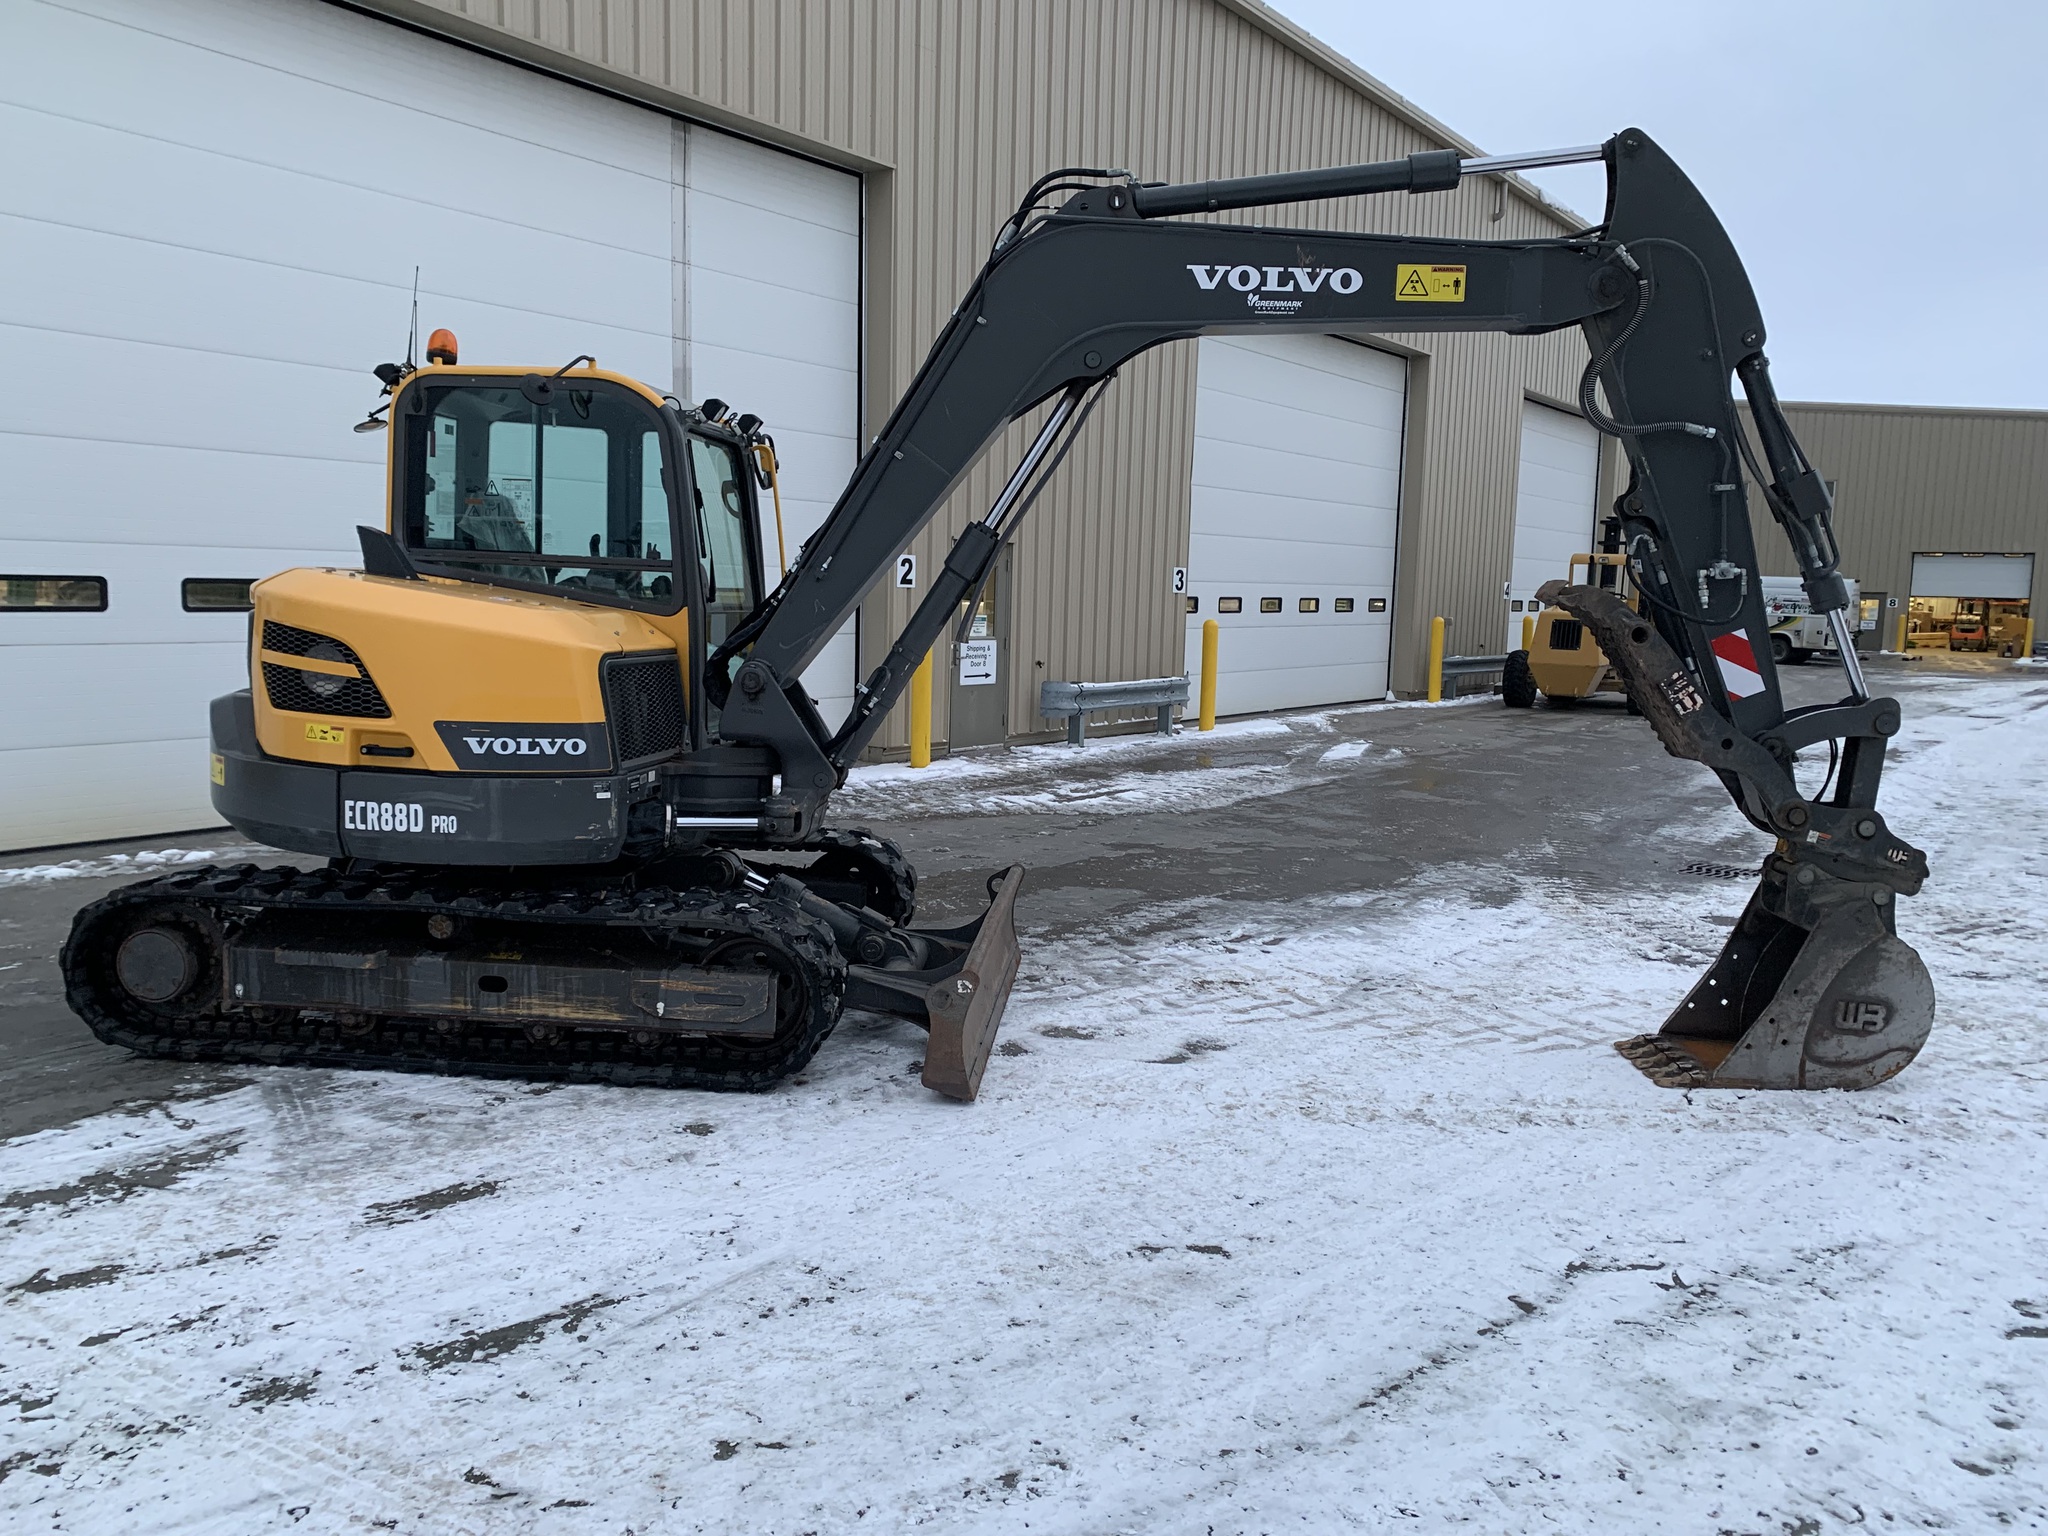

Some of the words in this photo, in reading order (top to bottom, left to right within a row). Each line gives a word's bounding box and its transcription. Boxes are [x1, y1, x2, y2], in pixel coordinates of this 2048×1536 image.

[1186, 264, 1363, 294] VOLVO
[900, 558, 913, 585] 2
[1174, 569, 1185, 591] 3
[1504, 583, 1510, 598] 4
[1889, 599, 1896, 607] 8
[966, 645, 986, 653] Shipping
[463, 737, 587, 755] VOLVO
[344, 800, 424, 833] ECR88D
[431, 815, 458, 834] PRO
